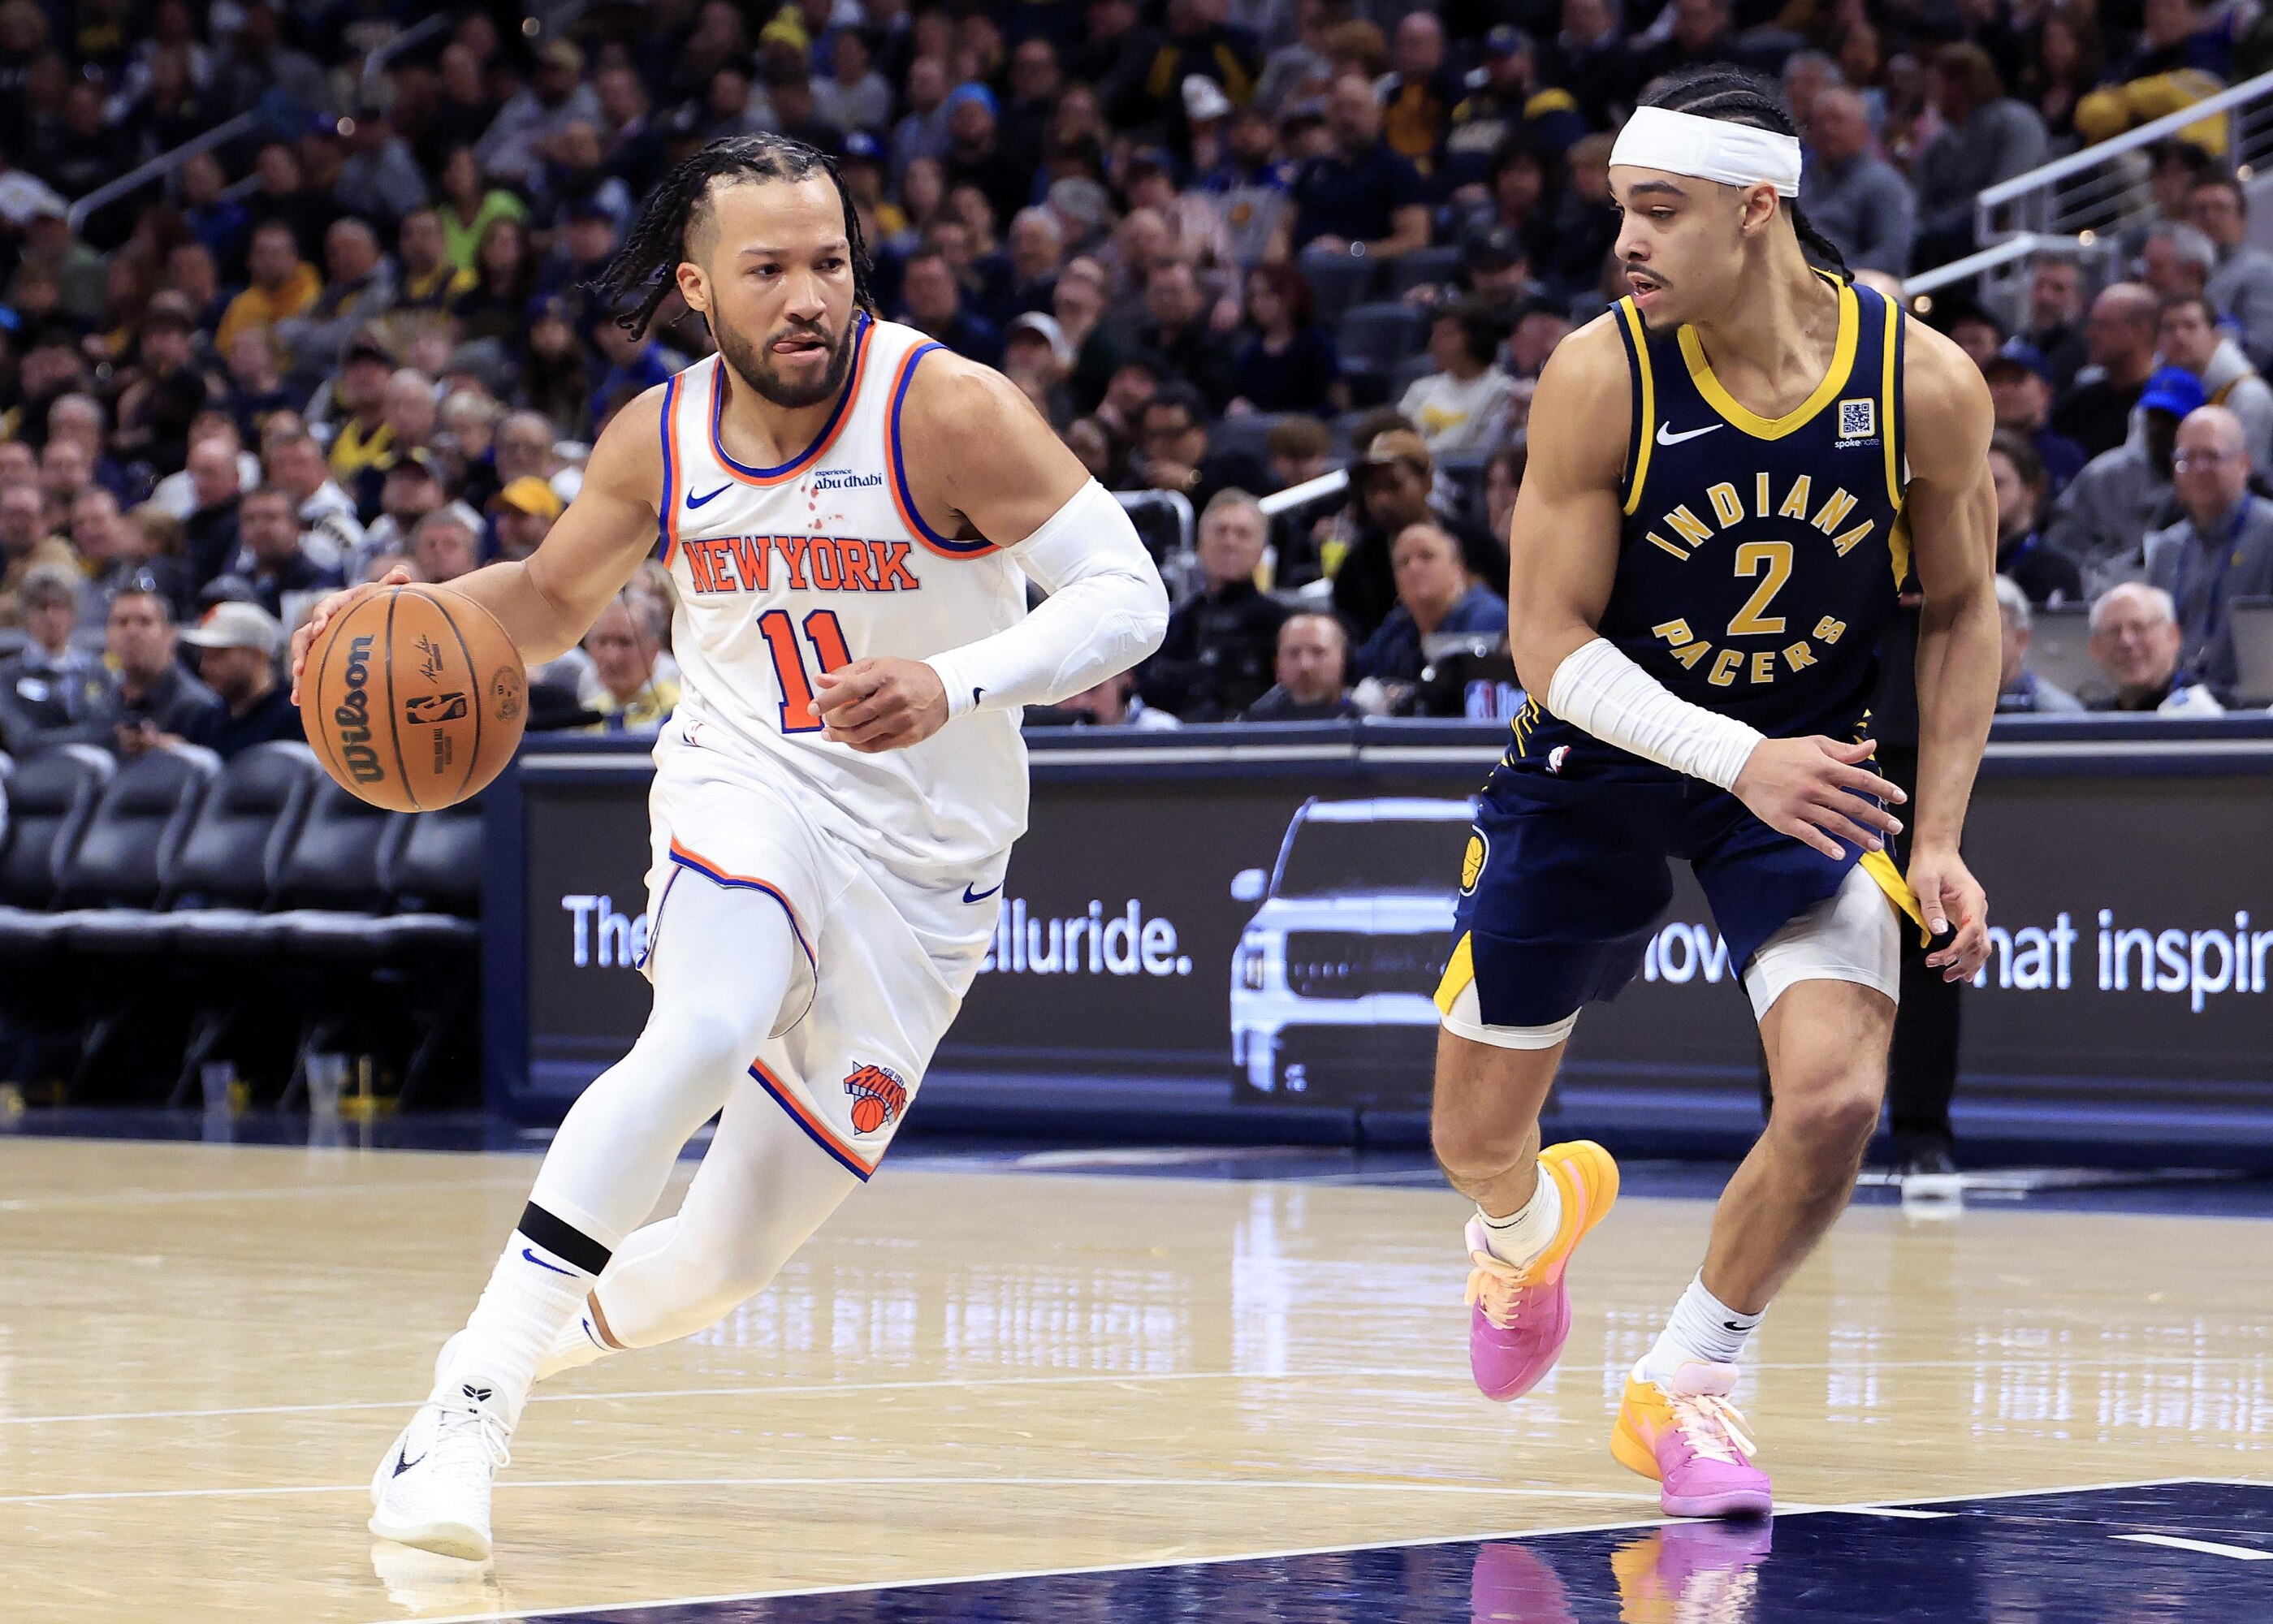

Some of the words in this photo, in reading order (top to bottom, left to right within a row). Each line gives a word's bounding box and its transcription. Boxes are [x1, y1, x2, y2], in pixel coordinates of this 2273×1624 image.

[815, 477, 841, 489] abu
[844, 473, 883, 487] dhabi
[1834, 438, 1879, 450] spokenote
[1645, 472, 1874, 560] INDIANA
[682, 534, 771, 594] NEW
[773, 534, 922, 594] YORK
[1726, 541, 1793, 636] 2
[757, 609, 853, 734] 11
[1652, 615, 1847, 686] PACERS
[335, 633, 385, 784] Wilson
